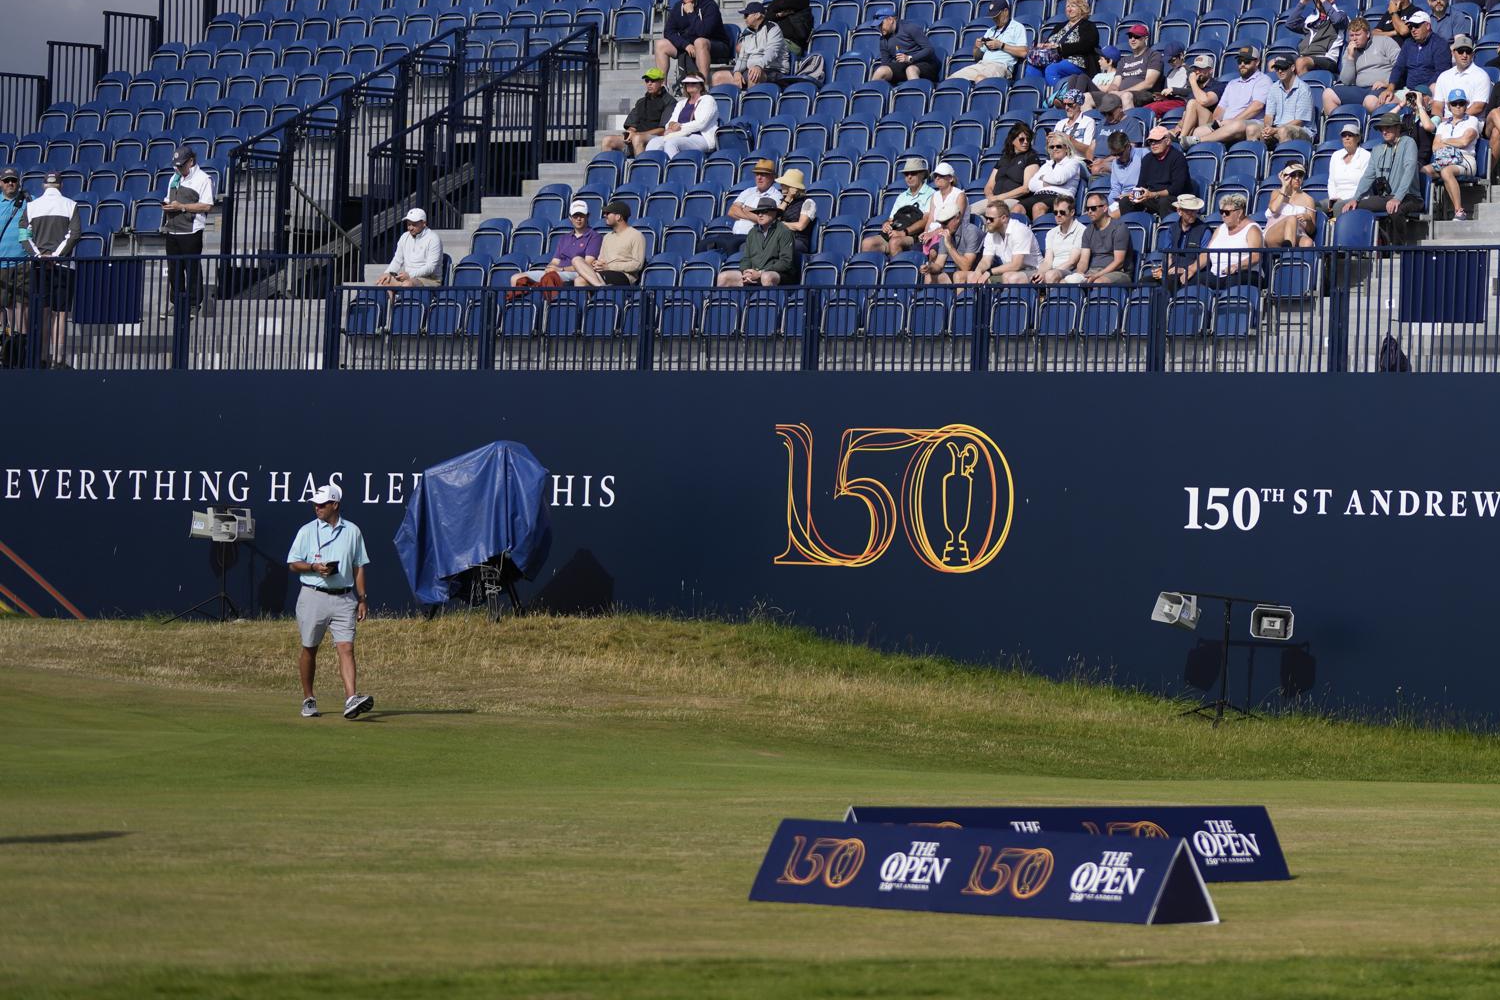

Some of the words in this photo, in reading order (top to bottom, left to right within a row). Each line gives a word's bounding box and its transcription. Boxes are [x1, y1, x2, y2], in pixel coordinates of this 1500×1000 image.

[5, 468, 250, 502] EVERYTHING
[269, 471, 343, 504] HAS
[551, 474, 616, 508] HIS
[774, 423, 1014, 574] 150
[1293, 488, 1333, 515] ST
[1204, 820, 1236, 833] THE
[909, 841, 940, 857] THE
[1100, 851, 1133, 867] THE
[1193, 830, 1261, 857] OPEN
[776, 836, 866, 888] 150
[880, 852, 952, 884] OPEN
[961, 845, 1055, 899] 150
[1070, 862, 1146, 895] OPEN
